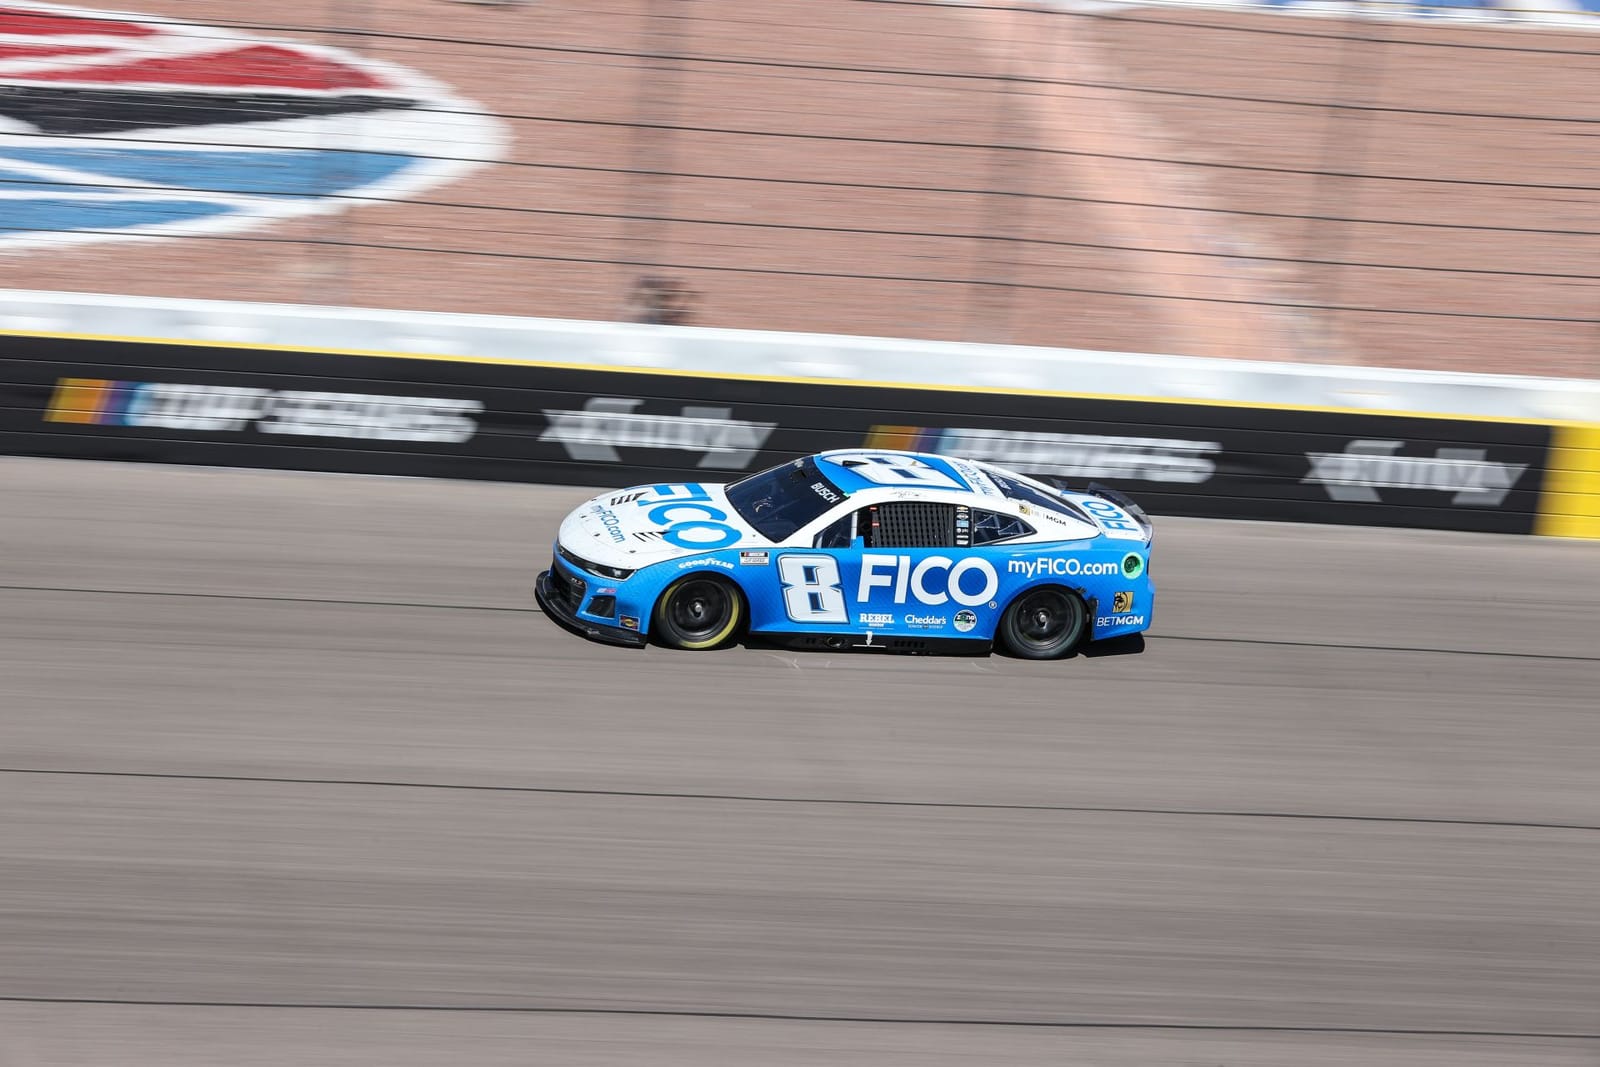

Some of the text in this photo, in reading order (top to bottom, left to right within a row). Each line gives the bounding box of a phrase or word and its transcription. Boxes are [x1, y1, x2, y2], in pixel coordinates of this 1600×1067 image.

[810, 482, 841, 504] BUSCH
[624, 482, 743, 550] FICO
[1081, 501, 1139, 531] FICO
[857, 553, 999, 606] FICO
[1007, 557, 1119, 579] myFICO.com
[778, 553, 850, 624] 8
[859, 613, 895, 624] REBEL
[1096, 615, 1145, 627] BETMGM
